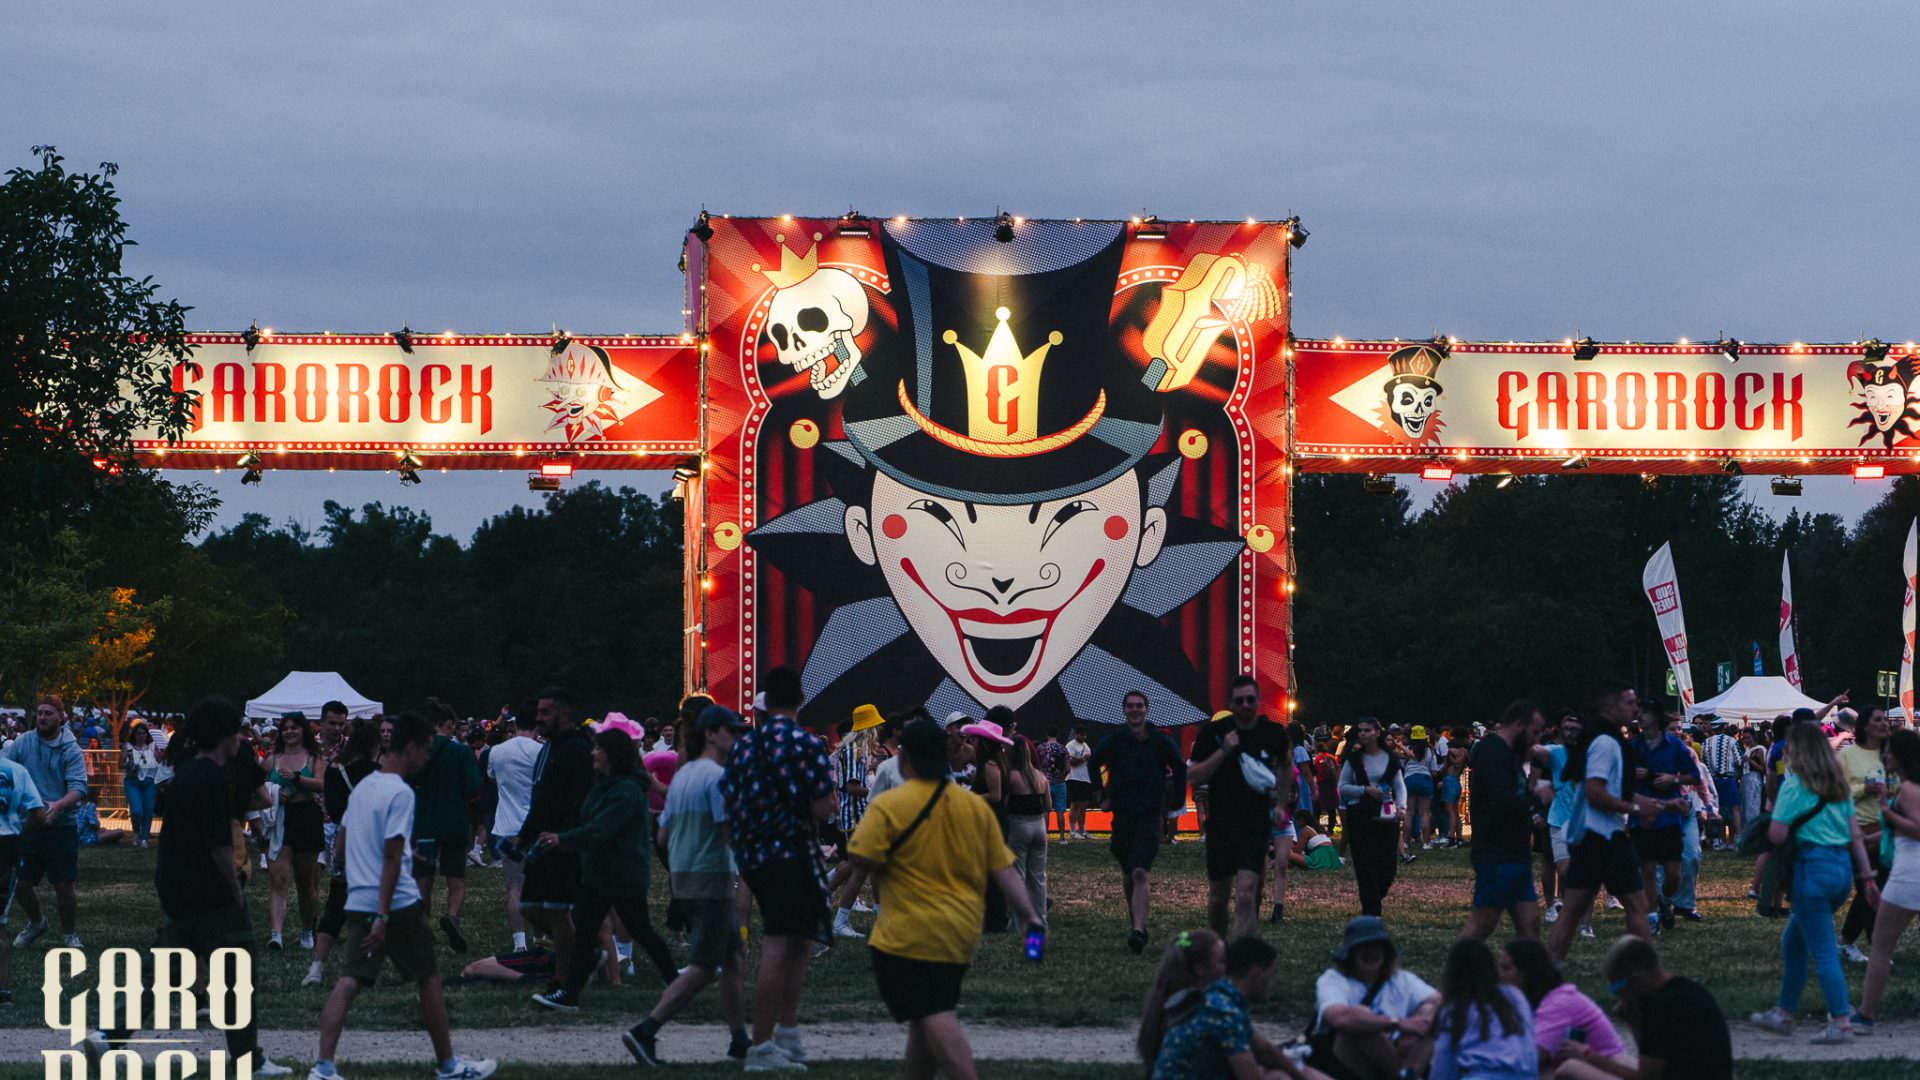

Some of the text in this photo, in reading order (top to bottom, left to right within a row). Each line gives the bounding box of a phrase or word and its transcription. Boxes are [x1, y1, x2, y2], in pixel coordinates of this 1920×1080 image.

[171, 362, 493, 436] GAROROCK
[985, 364, 1020, 437] G
[1496, 371, 1803, 442] GAROROCK
